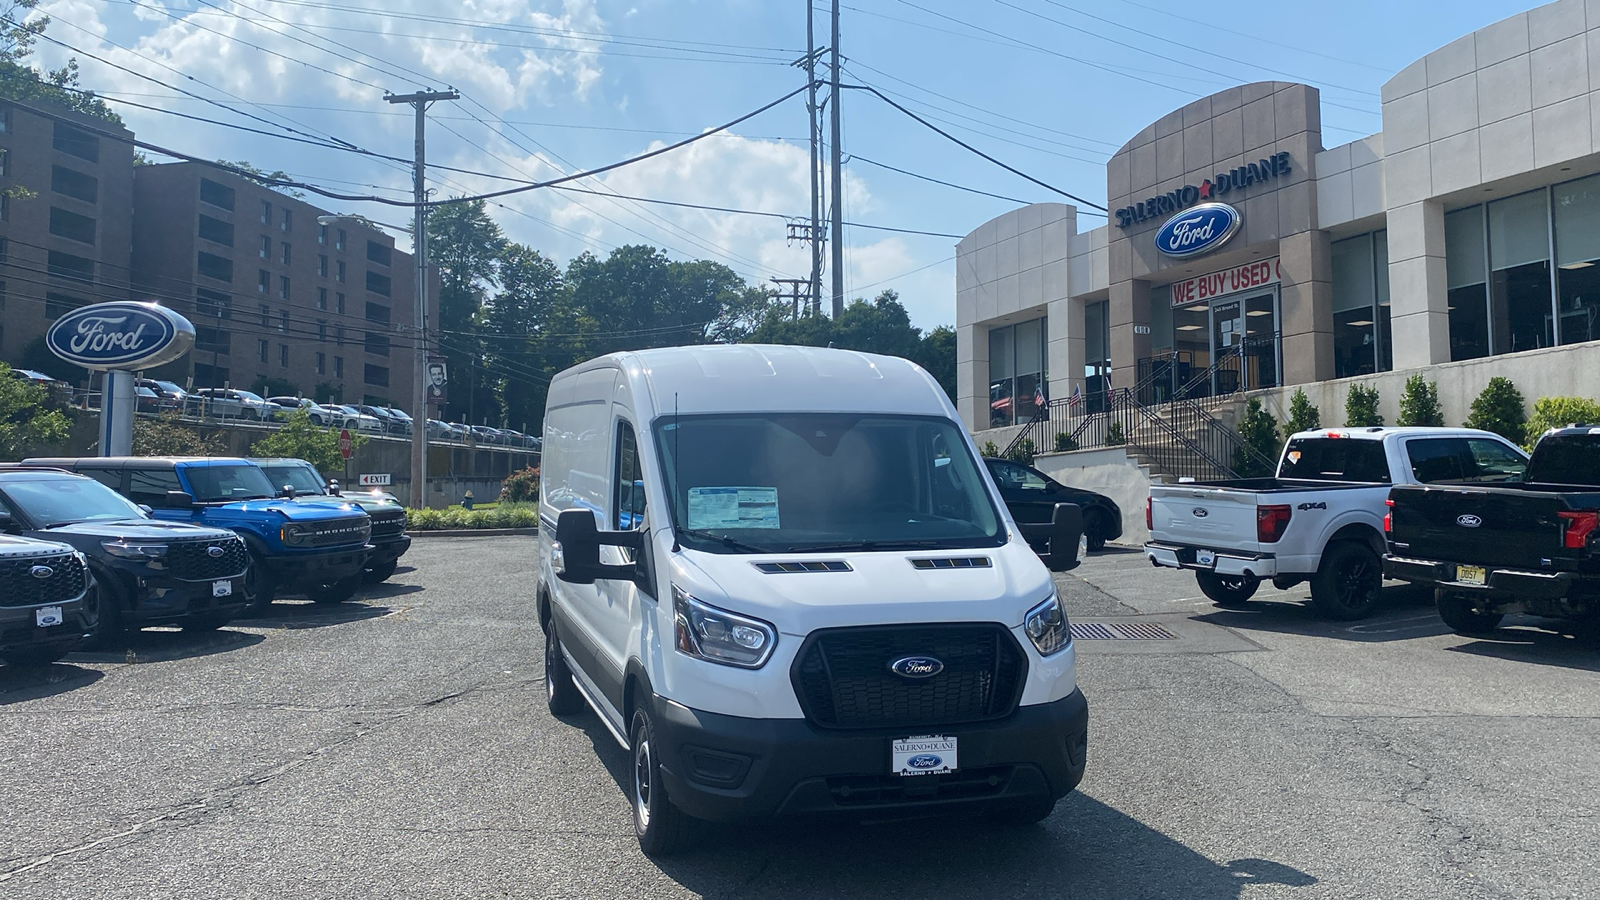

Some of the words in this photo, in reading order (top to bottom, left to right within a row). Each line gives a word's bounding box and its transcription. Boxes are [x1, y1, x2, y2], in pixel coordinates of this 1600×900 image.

[1115, 185, 1199, 228] SALERNO
[1215, 151, 1292, 195] DUANE
[1169, 215, 1216, 250] Ford
[1173, 281, 1194, 304] WE
[1199, 272, 1227, 299] BUY
[1231, 261, 1270, 291] USED
[70, 316, 147, 353] Ford
[370, 476, 387, 484] EXIT
[316, 526, 359, 535] BRONCO
[905, 660, 932, 673] Ford
[894, 743, 927, 752] SALERNO
[930, 742, 955, 750] DUANE
[914, 756, 936, 767] Ford
